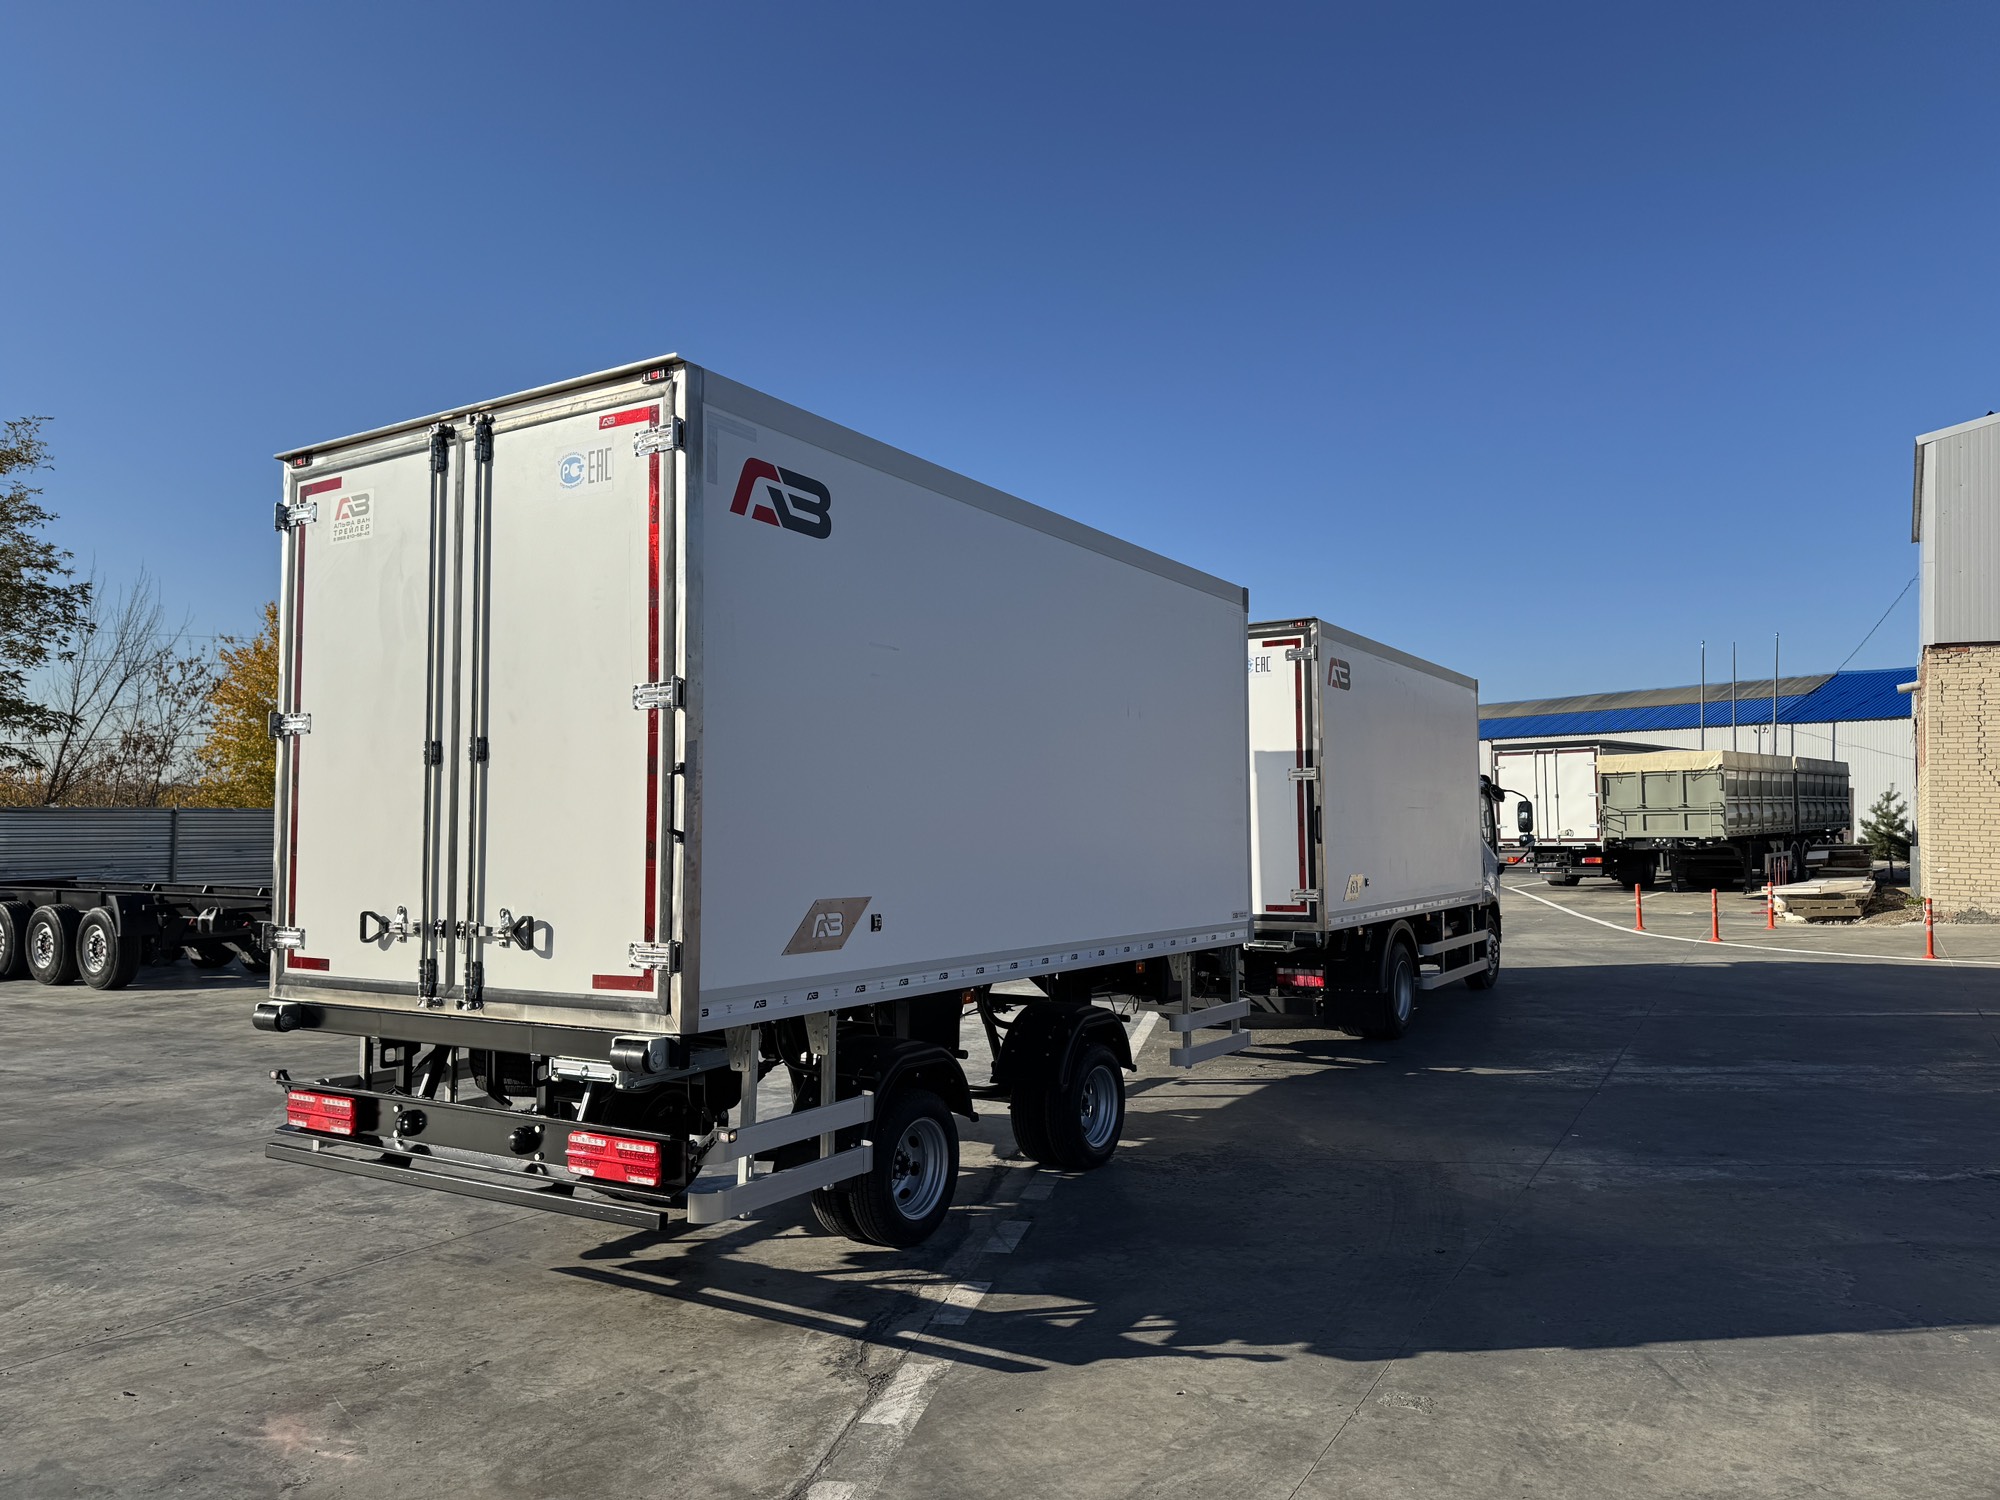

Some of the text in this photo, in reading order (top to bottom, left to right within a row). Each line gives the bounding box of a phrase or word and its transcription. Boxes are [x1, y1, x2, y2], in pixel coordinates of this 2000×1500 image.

[588, 447, 612, 484] EAC
[729, 457, 832, 539] АВ
[333, 524, 370, 536] ТРЕЙЛЕР
[357, 517, 370, 525] ВАН
[1255, 656, 1271, 673] EAC
[812, 912, 844, 938] АВ
